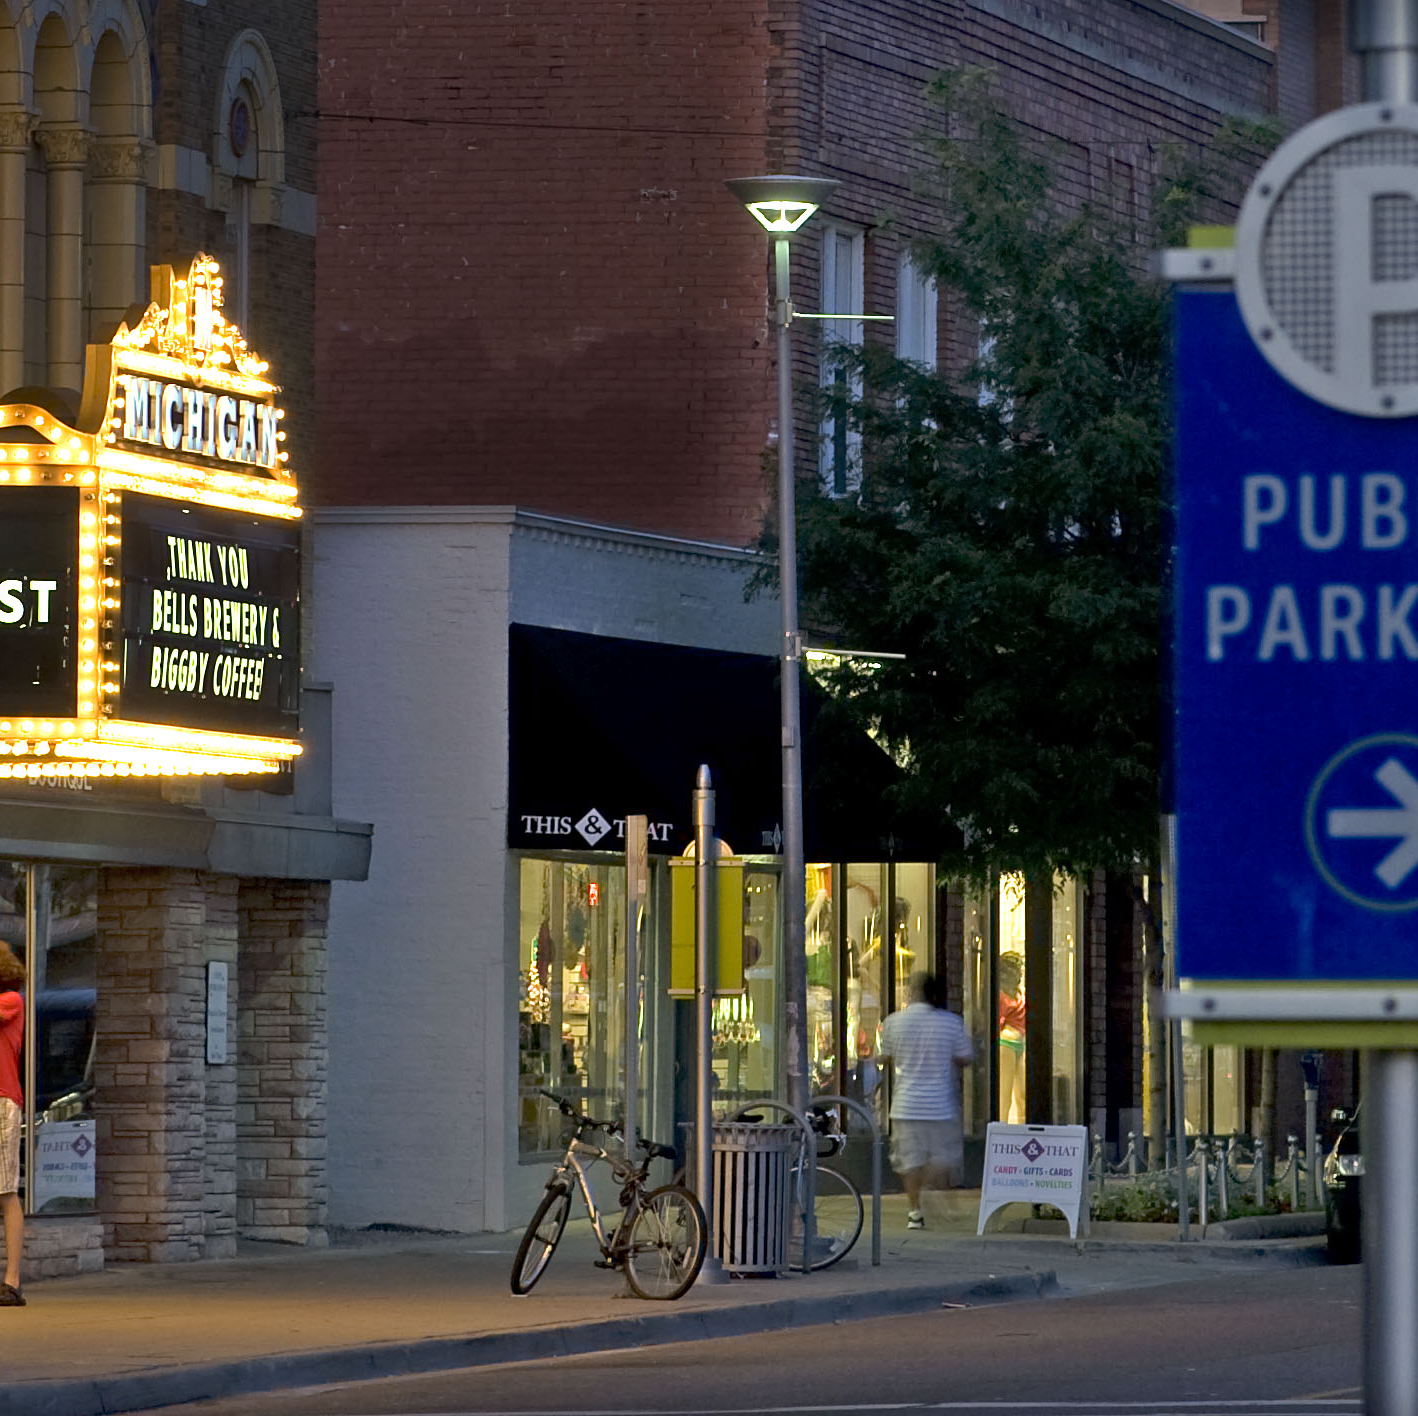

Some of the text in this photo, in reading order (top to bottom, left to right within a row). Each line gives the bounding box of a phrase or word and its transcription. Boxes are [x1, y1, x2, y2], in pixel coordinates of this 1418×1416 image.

[123, 375, 279, 470] MICHIGAN
[167, 536, 249, 590] THANK YOU
[152, 589, 280, 648] BELLS BREWERY &
[150, 645, 263, 701] BIGGBY COFFEE
[521, 815, 674, 842] THIS & TAT
[992, 1143, 1078, 1157] THIS & THAT
[993, 1165, 1073, 1177] CANDY GIFTS CARDS
